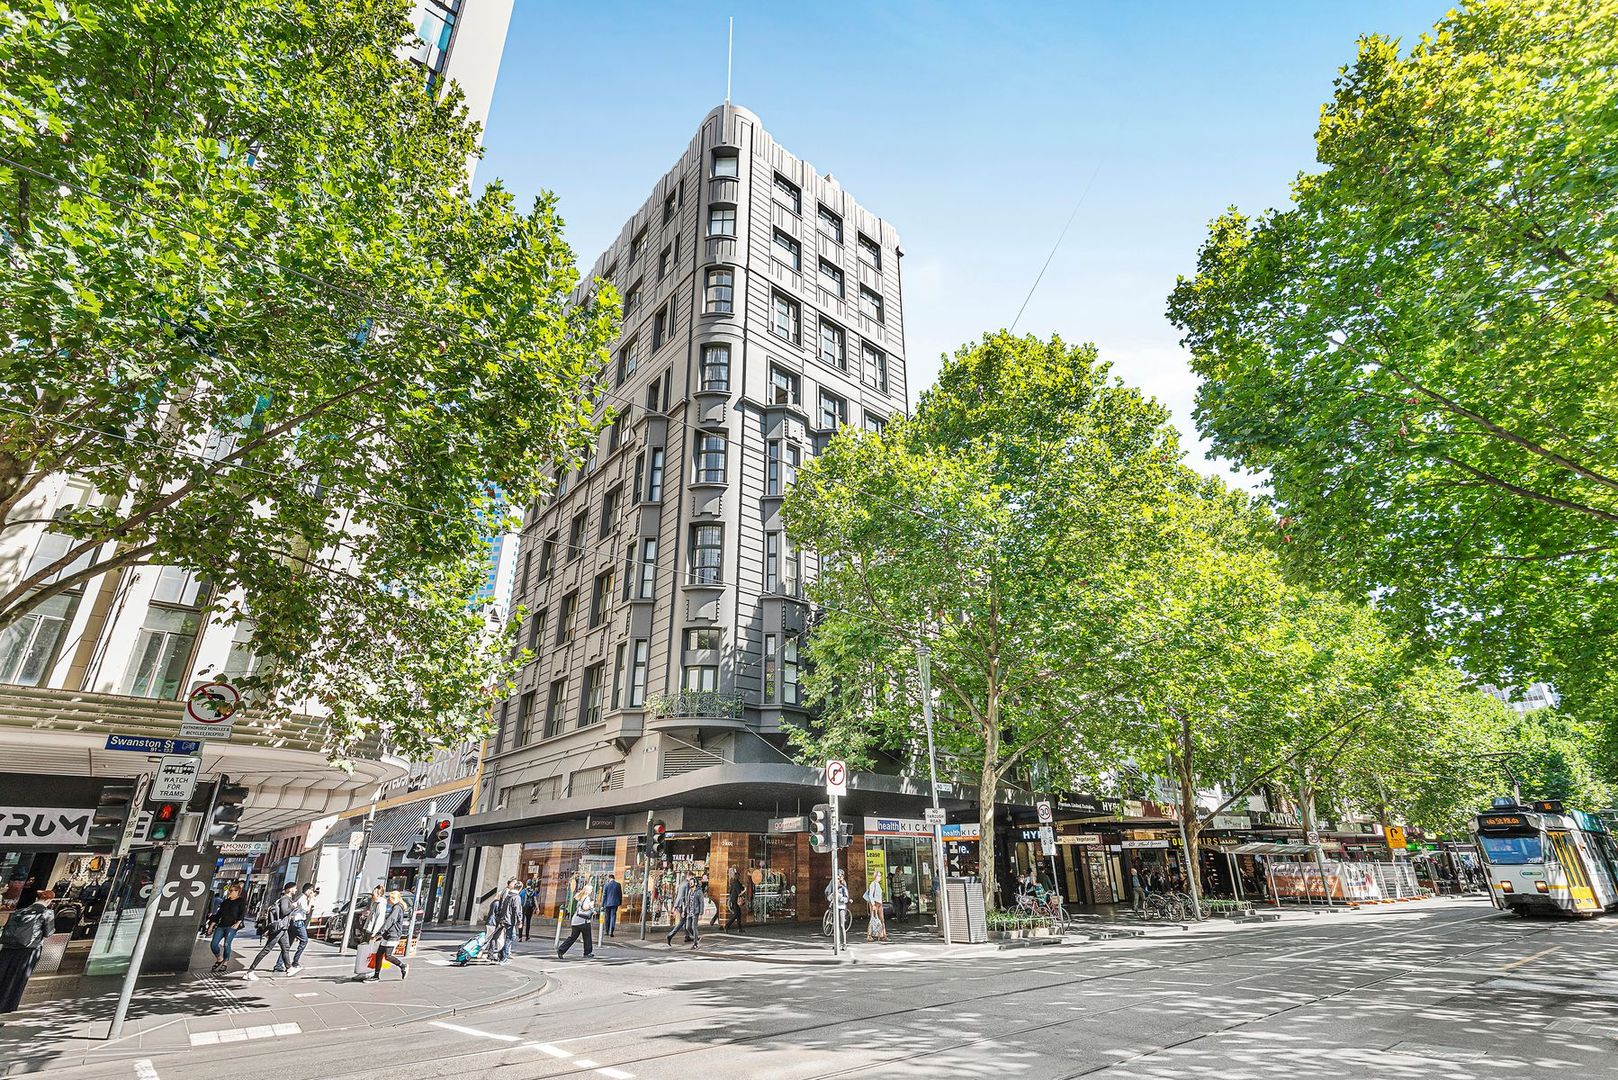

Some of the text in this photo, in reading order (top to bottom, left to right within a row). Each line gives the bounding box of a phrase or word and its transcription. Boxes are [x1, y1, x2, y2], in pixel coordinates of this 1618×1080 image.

[110, 736, 176, 750] Swanston St
[0, 814, 90, 837] RUM
[877, 820, 899, 831] health
